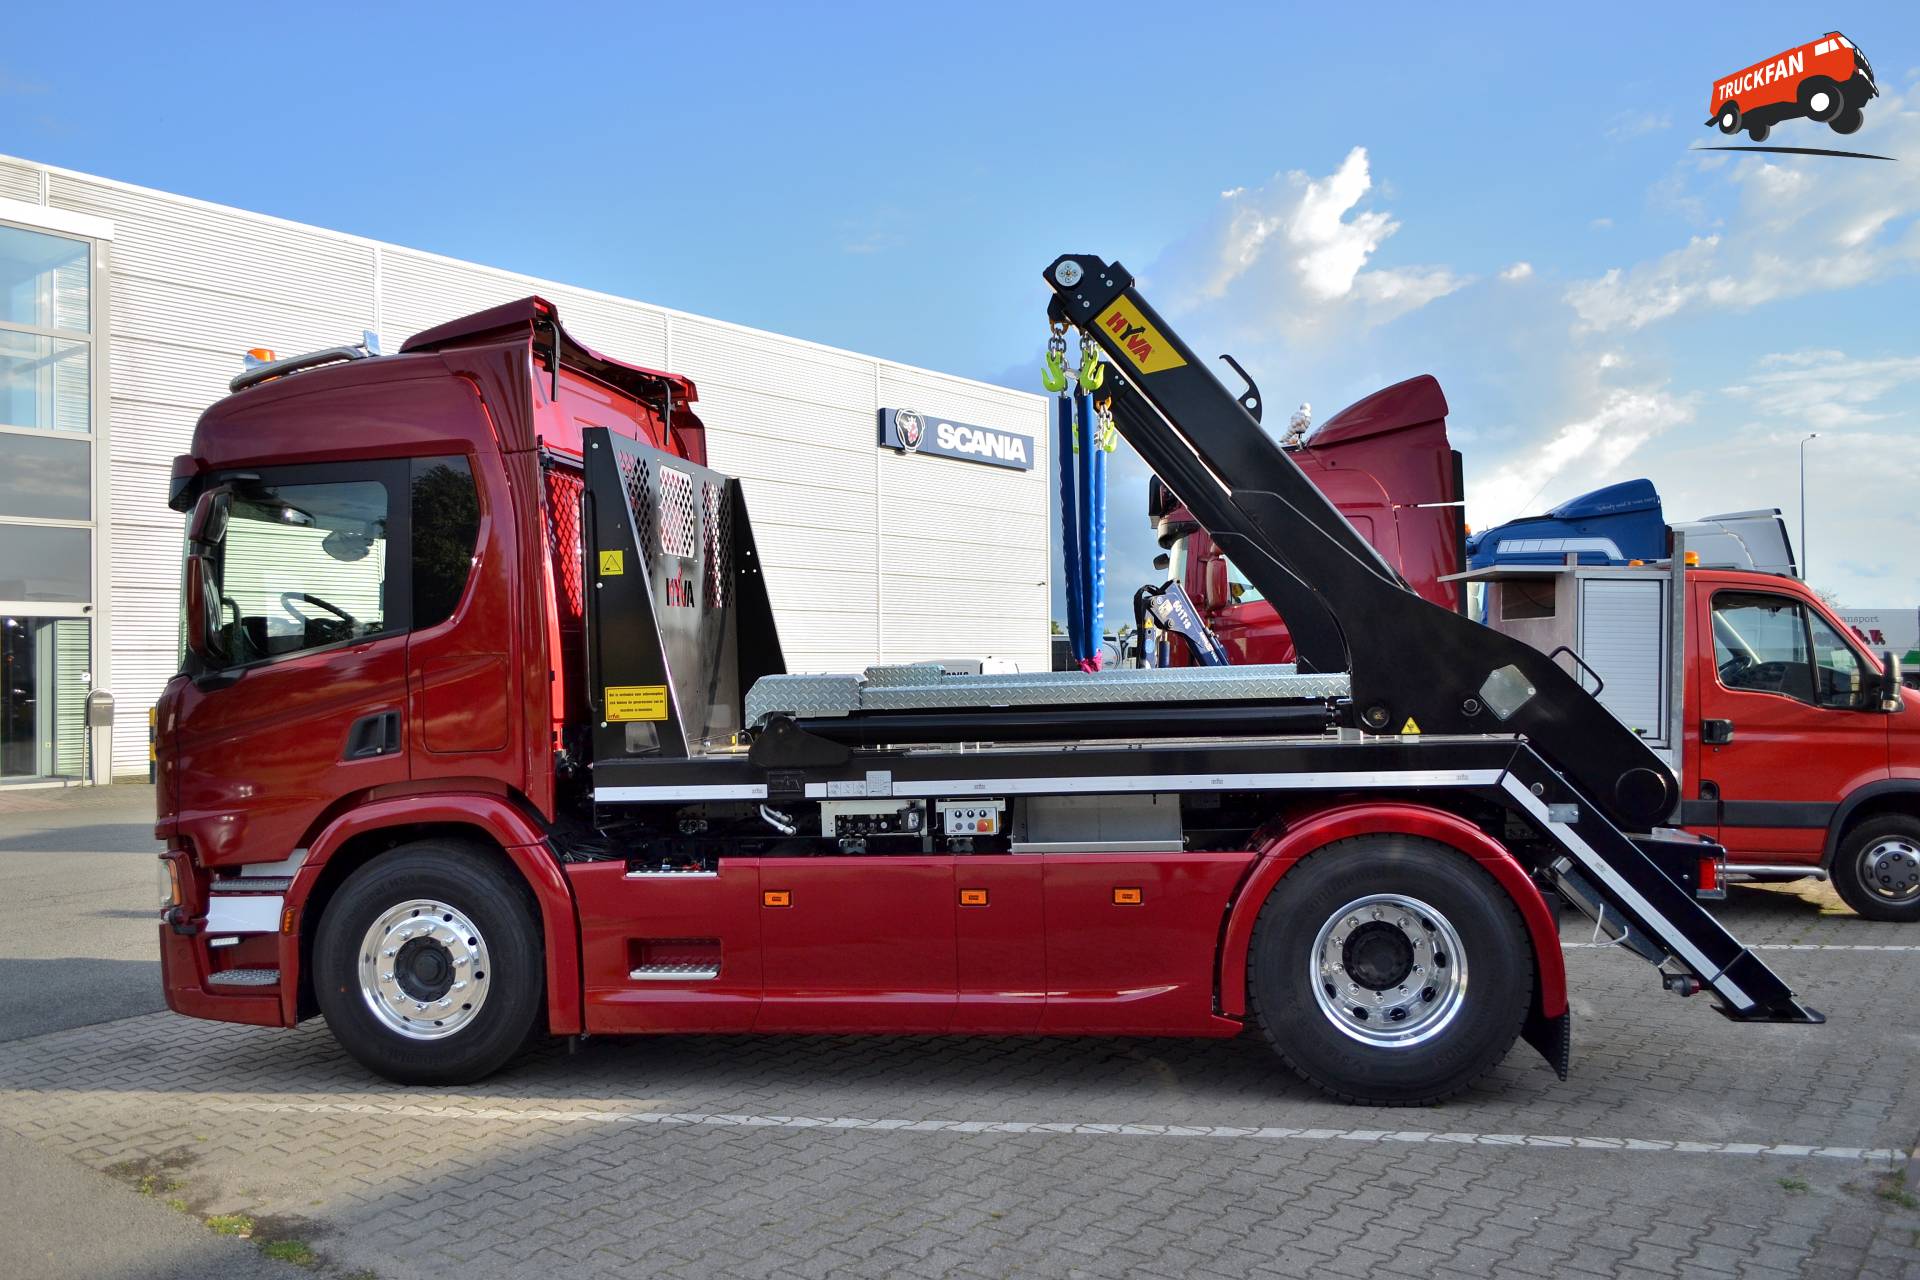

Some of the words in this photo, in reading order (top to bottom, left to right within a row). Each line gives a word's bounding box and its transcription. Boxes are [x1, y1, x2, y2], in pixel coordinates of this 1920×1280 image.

[1106, 311, 1153, 364] HYVA
[936, 423, 1027, 463] SCANIA
[1839, 616, 1880, 624] ansport
